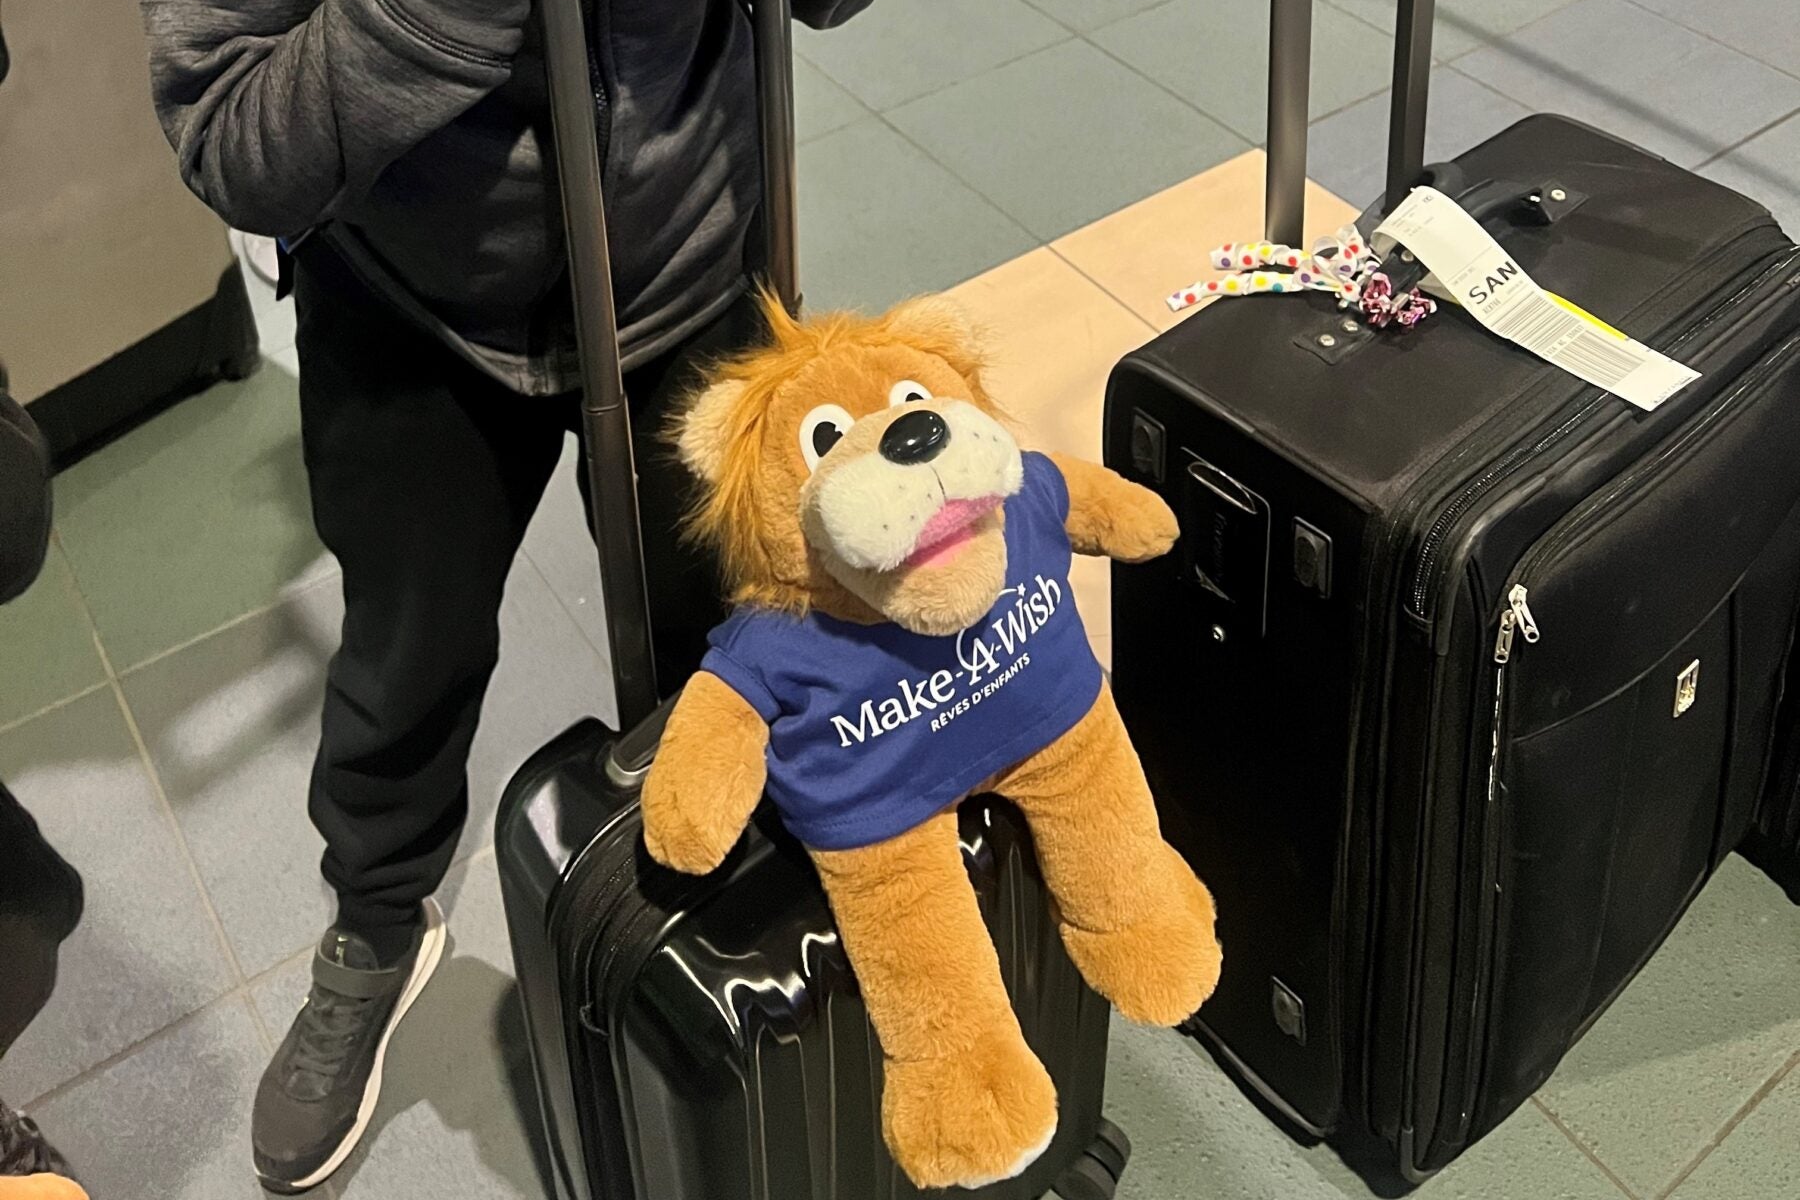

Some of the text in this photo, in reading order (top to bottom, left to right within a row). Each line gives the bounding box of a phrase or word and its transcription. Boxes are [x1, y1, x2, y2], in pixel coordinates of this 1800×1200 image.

[1469, 260, 1518, 305] SAN
[930, 652, 1031, 732] RÊVES D'ENFANTS
